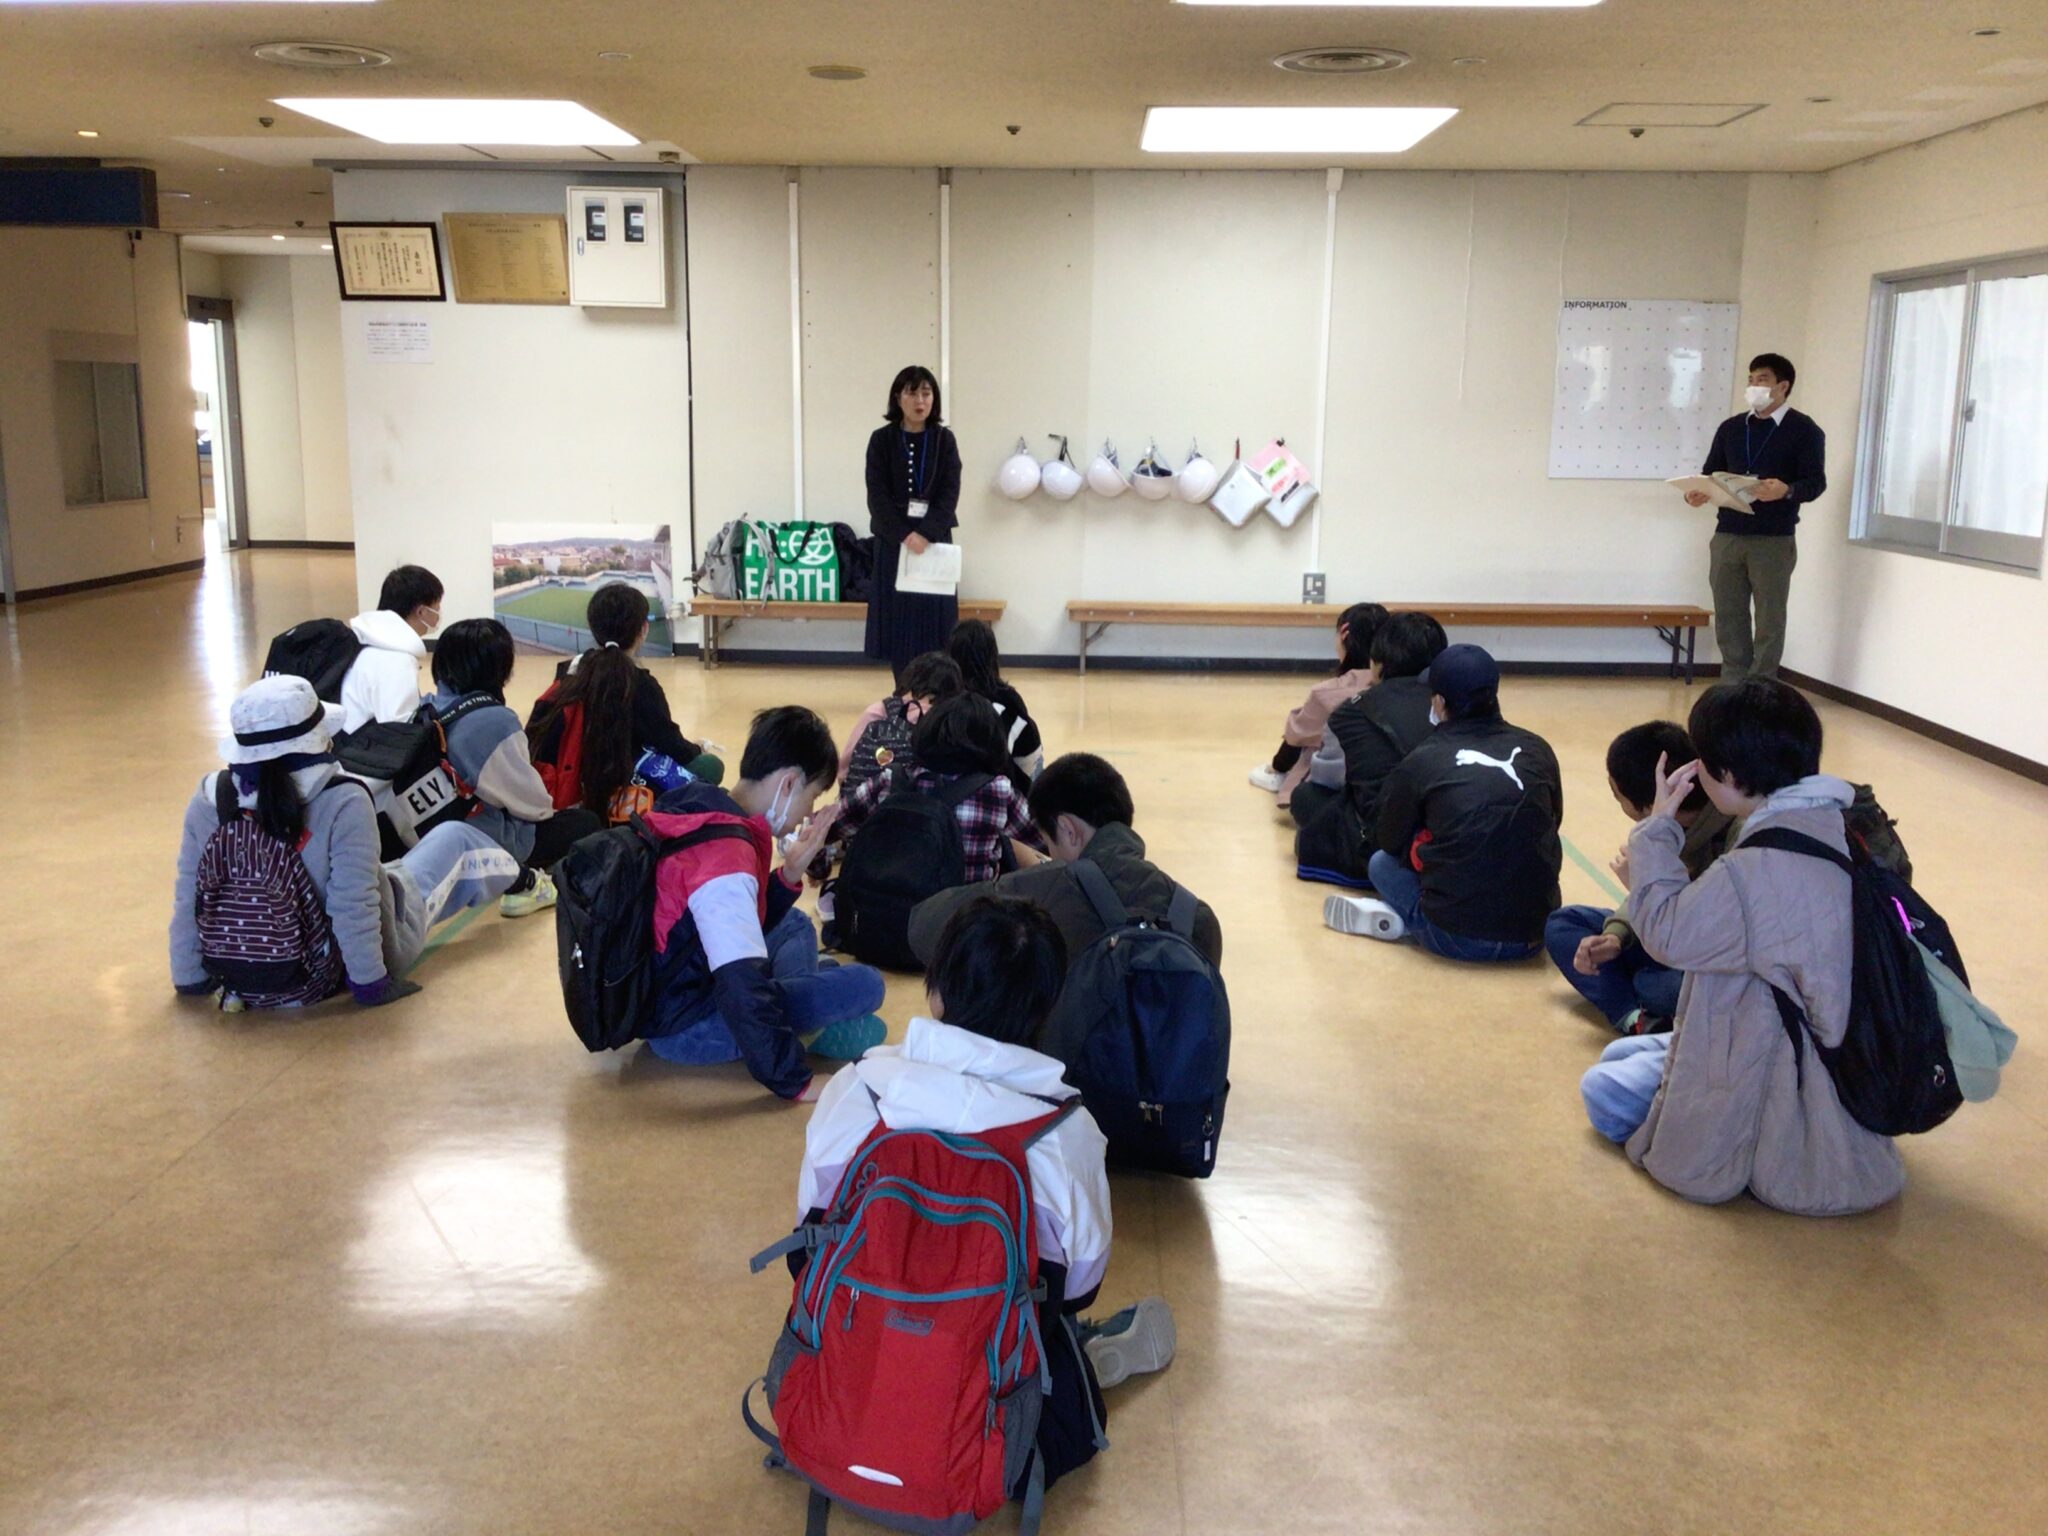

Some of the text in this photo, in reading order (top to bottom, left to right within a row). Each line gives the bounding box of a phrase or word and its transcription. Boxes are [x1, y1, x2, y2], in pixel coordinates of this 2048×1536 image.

[1564, 300, 1627, 309] INFORMATION
[745, 567, 836, 601] EARTH
[407, 776, 446, 816] ELY
